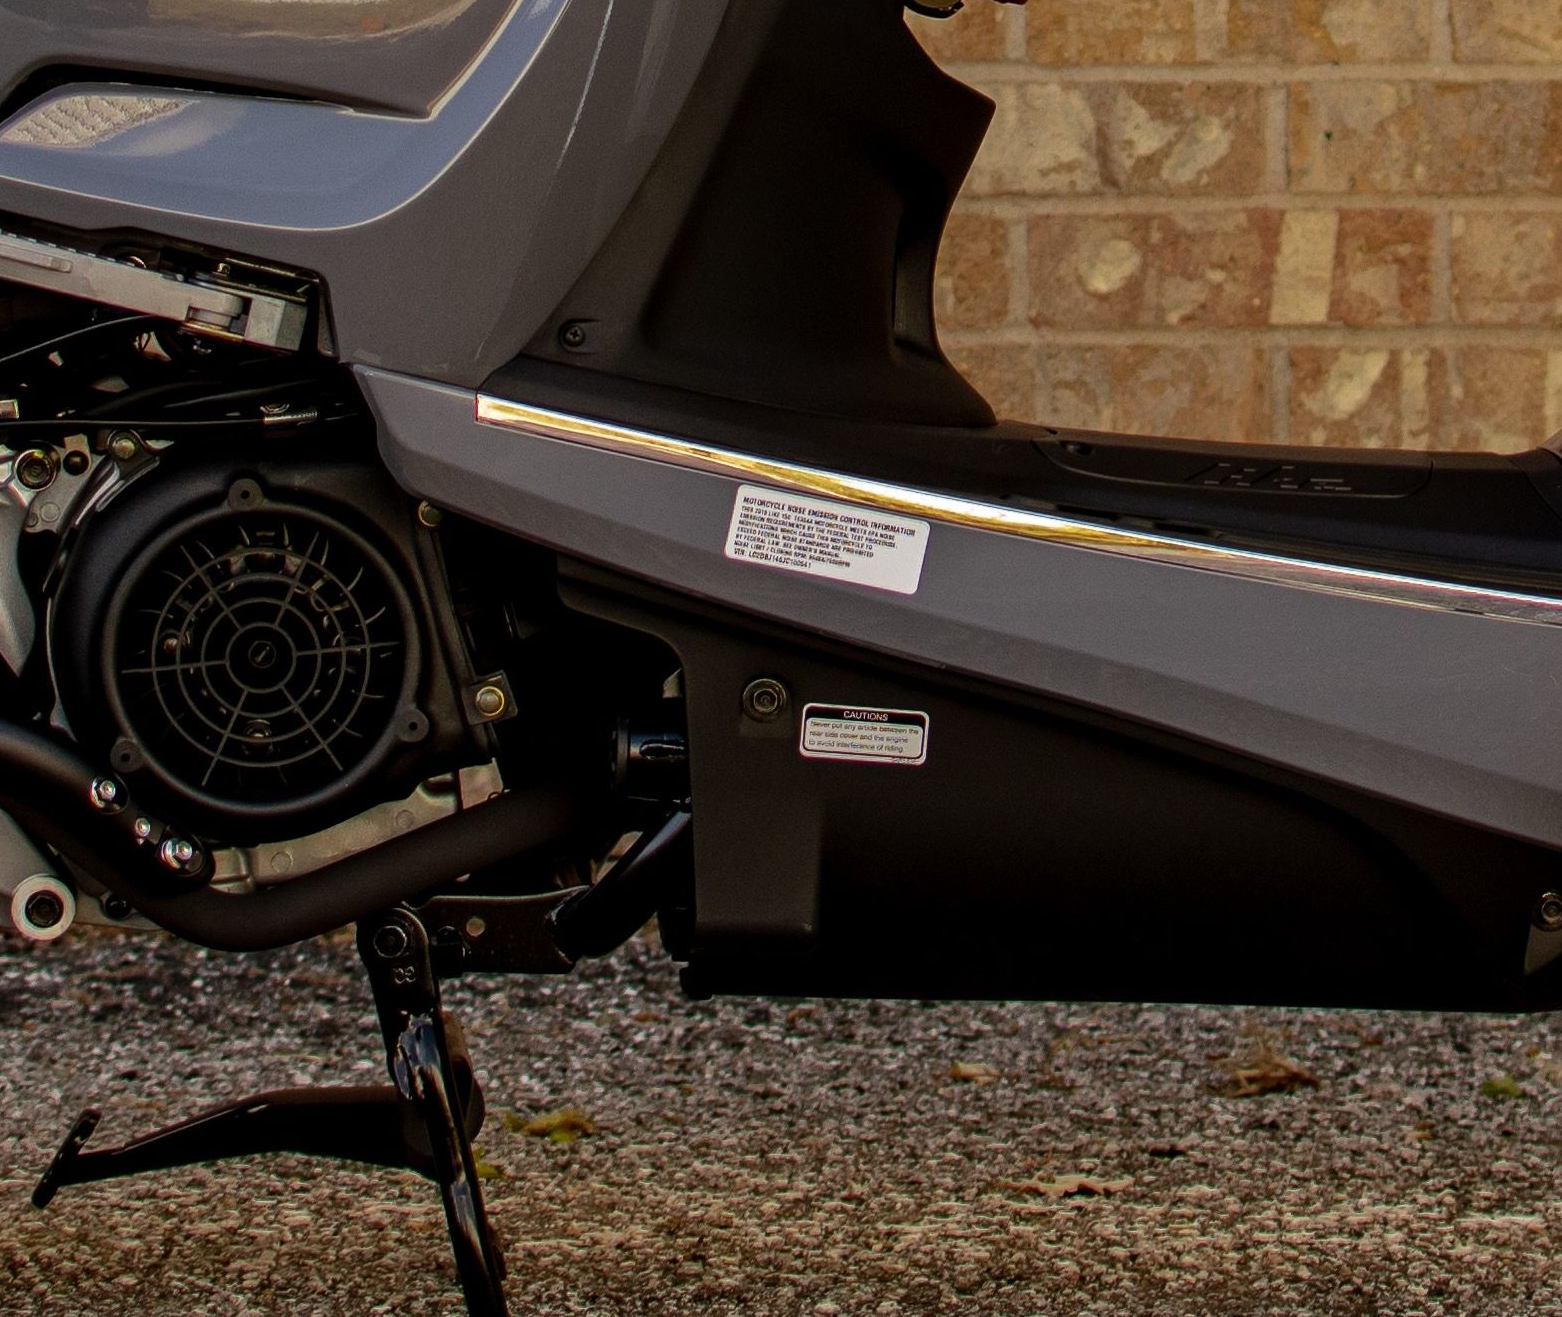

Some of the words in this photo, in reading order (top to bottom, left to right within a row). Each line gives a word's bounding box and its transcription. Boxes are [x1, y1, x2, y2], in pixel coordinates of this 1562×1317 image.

[743, 497, 786, 510] MOTORCYCLE
[788, 505, 806, 514] NOISE
[808, 509, 838, 521] EMISSION
[840, 515, 870, 527] CONTROL
[871, 521, 916, 536] INFORMATION
[843, 711, 889, 722] CAUTIONS
